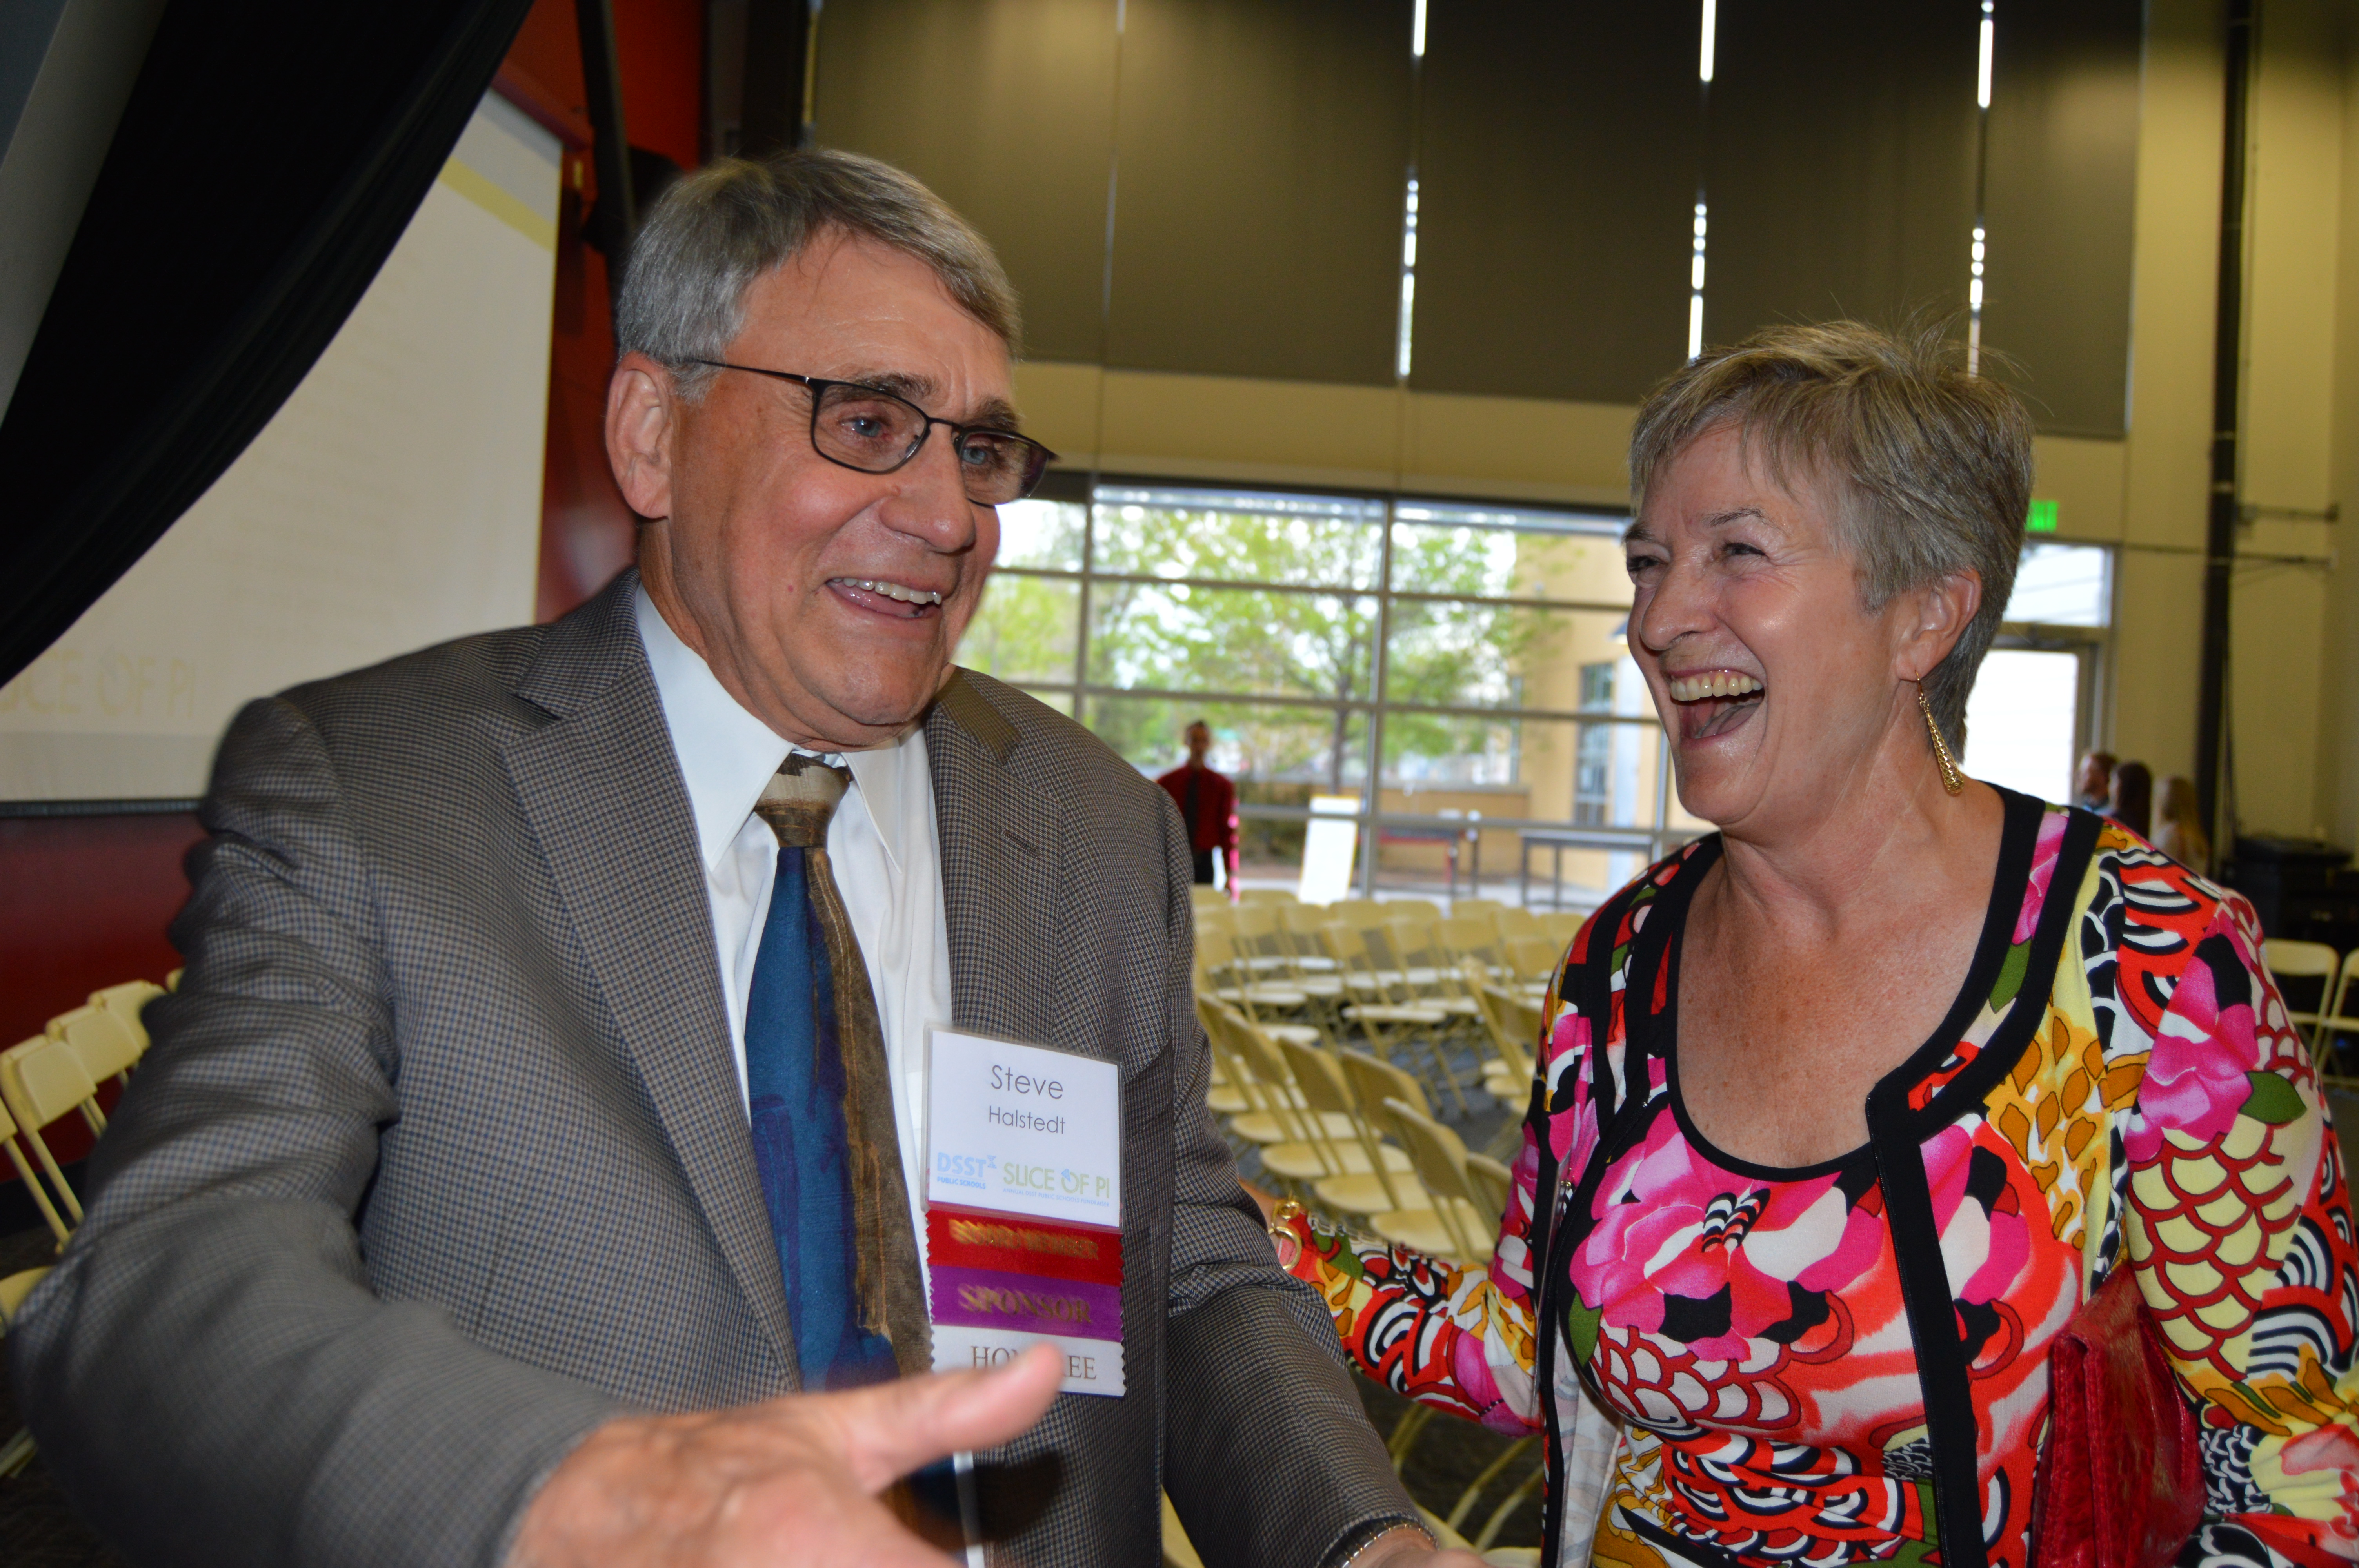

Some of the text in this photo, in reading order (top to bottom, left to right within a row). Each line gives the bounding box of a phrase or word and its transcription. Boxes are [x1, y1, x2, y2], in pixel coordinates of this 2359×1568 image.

[96, 650, 156, 717] OF
[166, 657, 197, 718] PI
[990, 1065, 1063, 1099] Steve
[989, 1105, 1065, 1134] Halstedt
[937, 1152, 987, 1178] DSST
[1003, 1162, 1110, 1198] SLICE OF PI
[937, 1176, 986, 1189] PUBLIC SCHOOLS
[1081, 1198, 1110, 1207] FUNDRAISER
[958, 1283, 1092, 1324] SPONSOR
[970, 1345, 1097, 1380] HOEE
